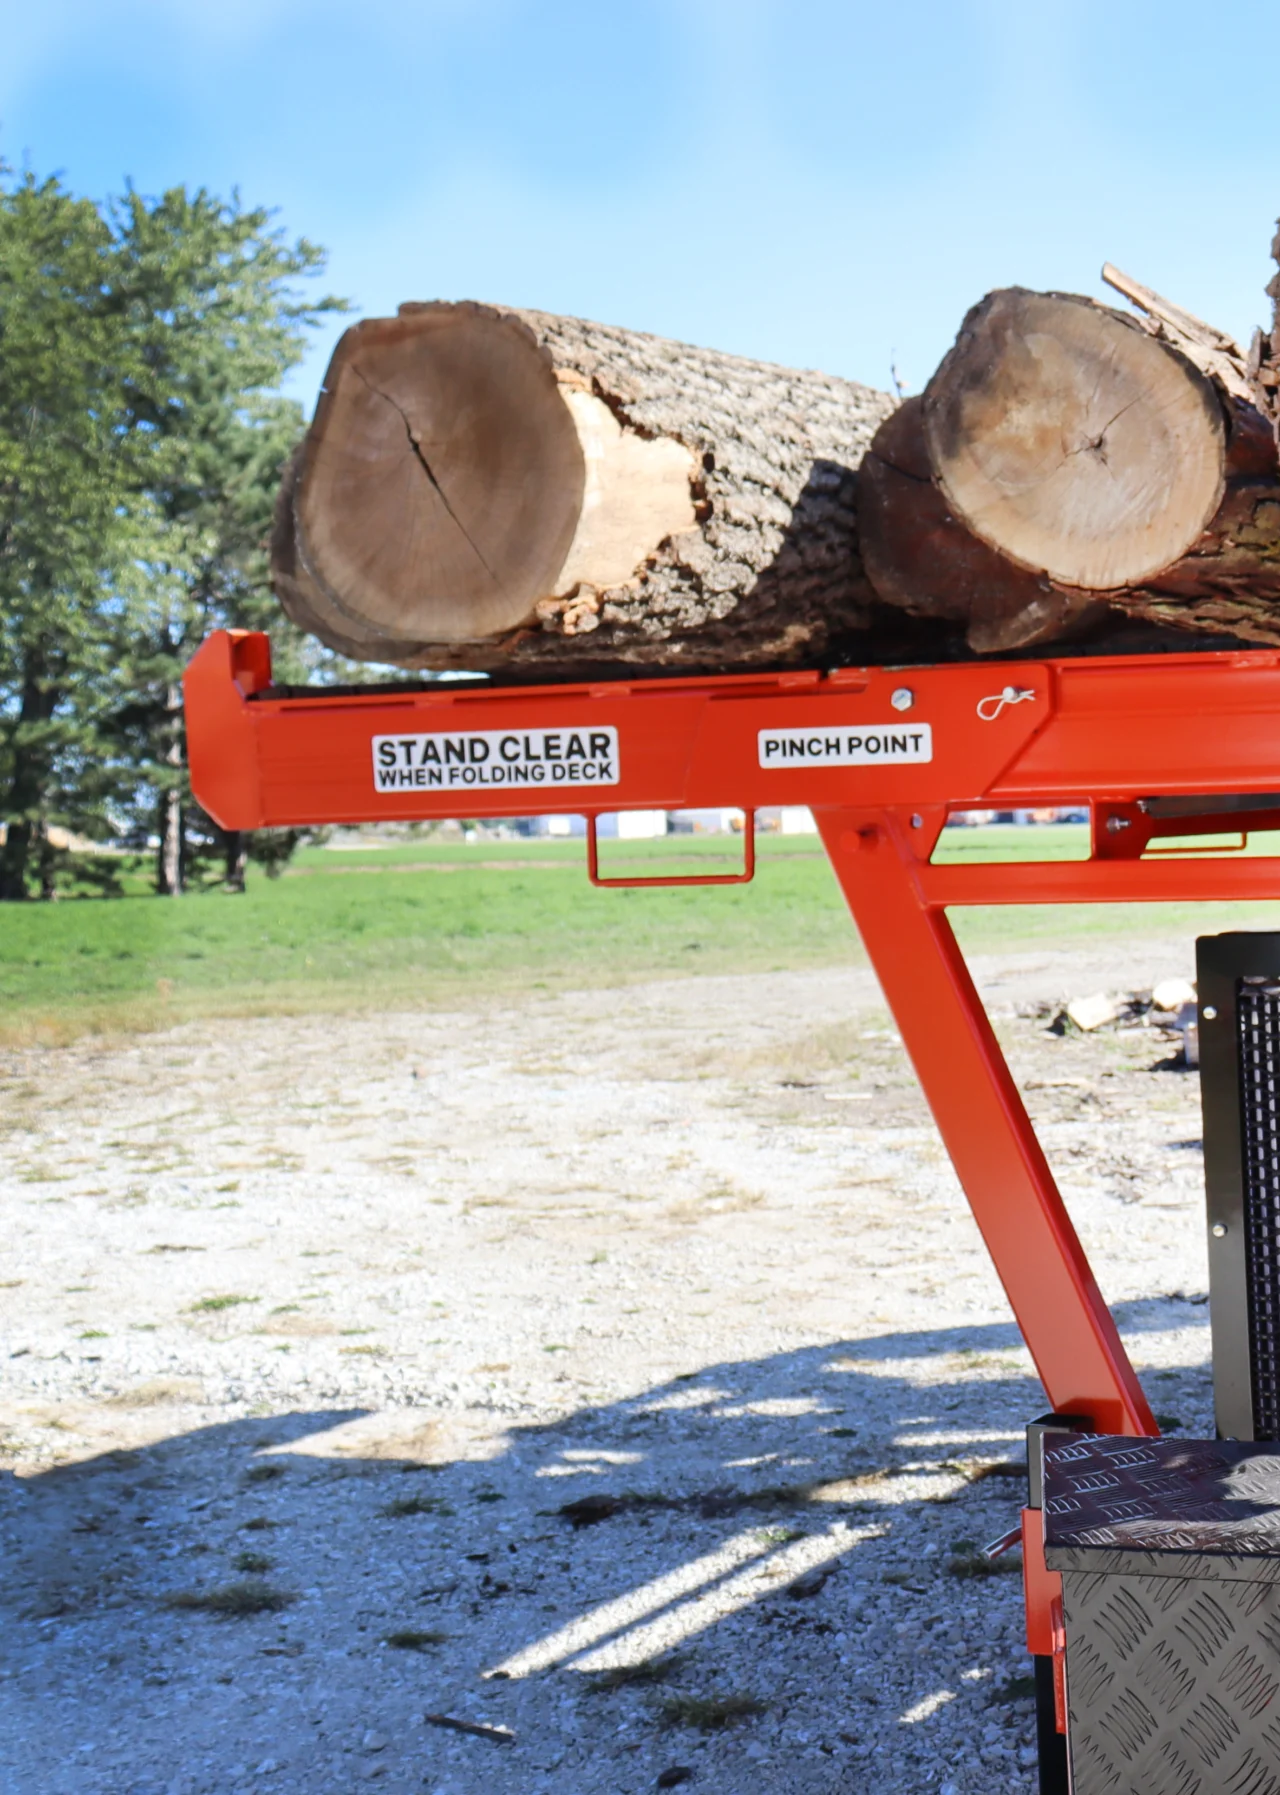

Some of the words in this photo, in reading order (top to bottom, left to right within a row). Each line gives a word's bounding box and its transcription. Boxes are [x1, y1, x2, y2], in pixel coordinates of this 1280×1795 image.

[379, 738, 490, 766] STAND
[499, 733, 611, 762] CLEAR
[765, 738, 841, 758] PINCH
[848, 734, 924, 755] POINT
[379, 767, 443, 787] WHEN
[449, 763, 545, 784] FOLDING
[552, 761, 613, 781] DECK
